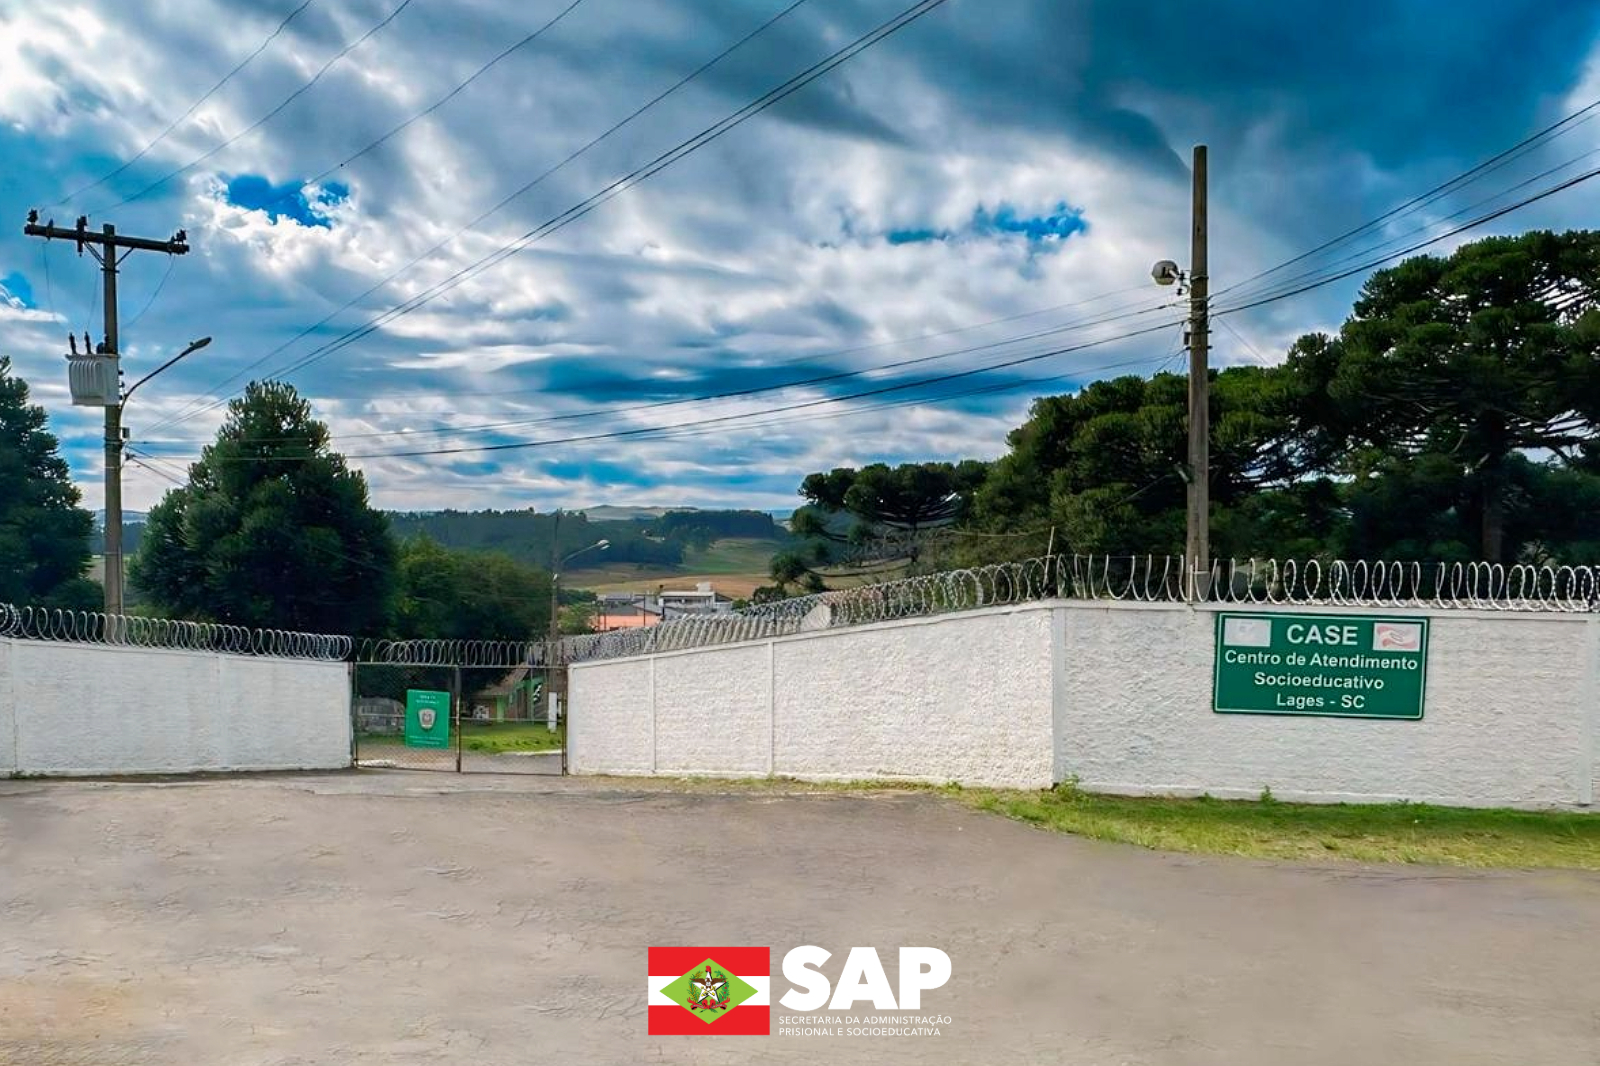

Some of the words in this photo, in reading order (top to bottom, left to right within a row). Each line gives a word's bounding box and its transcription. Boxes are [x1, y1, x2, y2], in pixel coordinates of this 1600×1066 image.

[1286, 623, 1359, 646] CASE
[1224, 650, 1281, 665] Centro
[1285, 652, 1306, 666] de
[1309, 652, 1418, 670] Atendimento
[1254, 672, 1384, 690] Socioeducativo
[1276, 693, 1325, 710] Lages
[1341, 695, 1366, 709] SC
